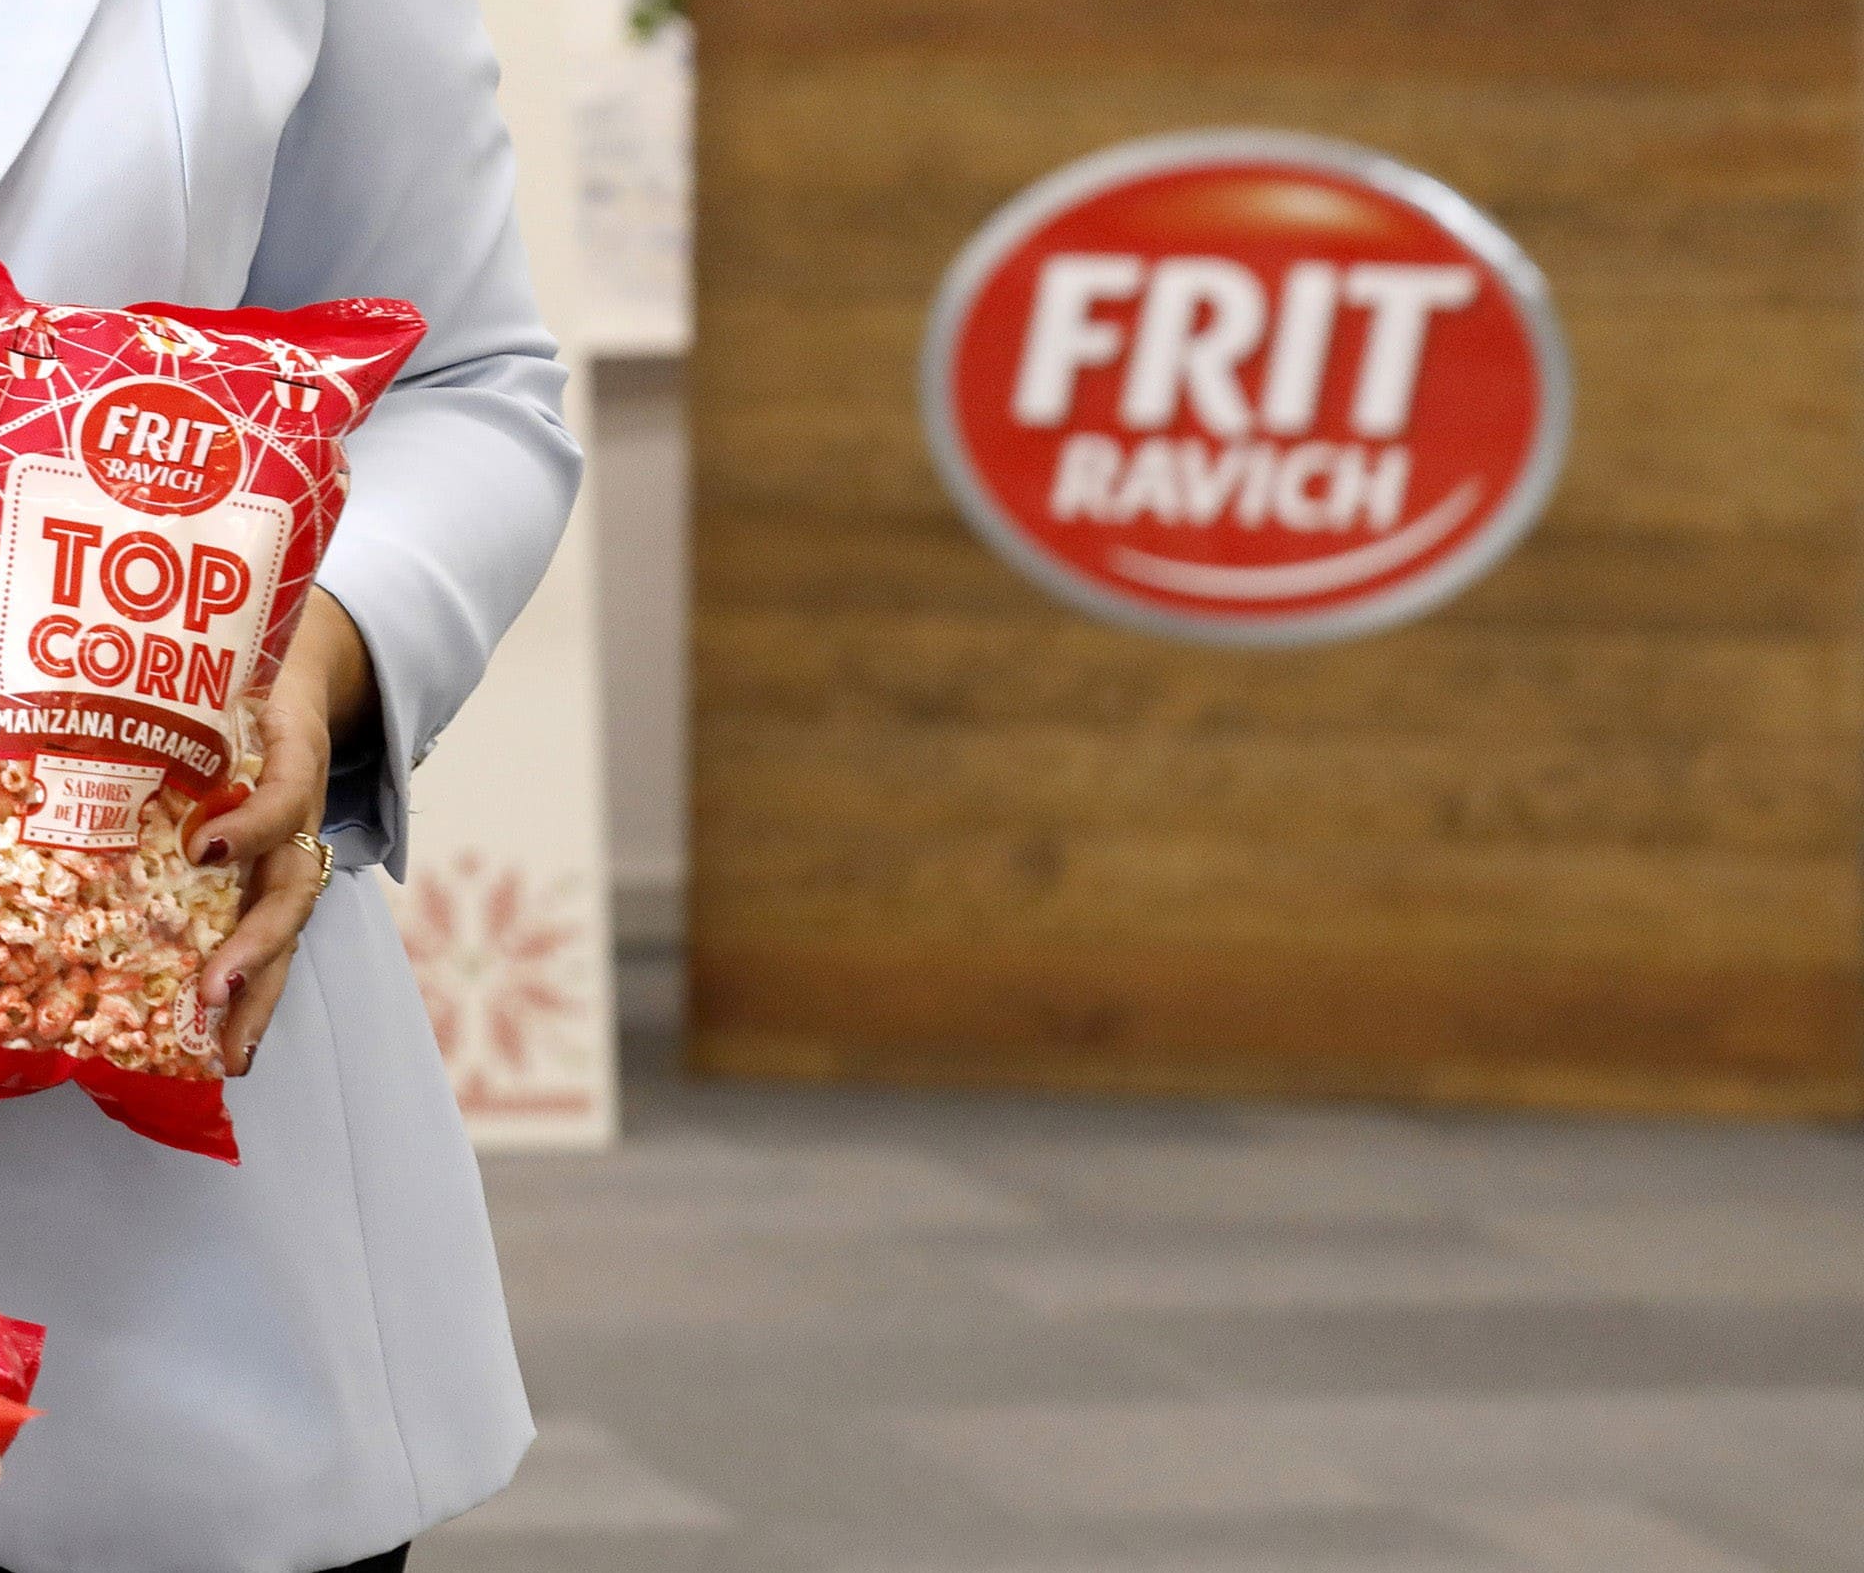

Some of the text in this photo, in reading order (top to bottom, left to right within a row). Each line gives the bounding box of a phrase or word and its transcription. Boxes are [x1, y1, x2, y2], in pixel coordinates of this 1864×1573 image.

[1010, 251, 1482, 439] FRIT
[98, 402, 228, 468] FRIT
[105, 457, 204, 494] RAVICH
[1048, 430, 1412, 531] RAVICH
[41, 516, 252, 634] TOP
[28, 613, 236, 712] CORN
[119, 717, 222, 778] CARAMELO
[54, 804, 72, 822] DE
[62, 777, 134, 802] SABORES
